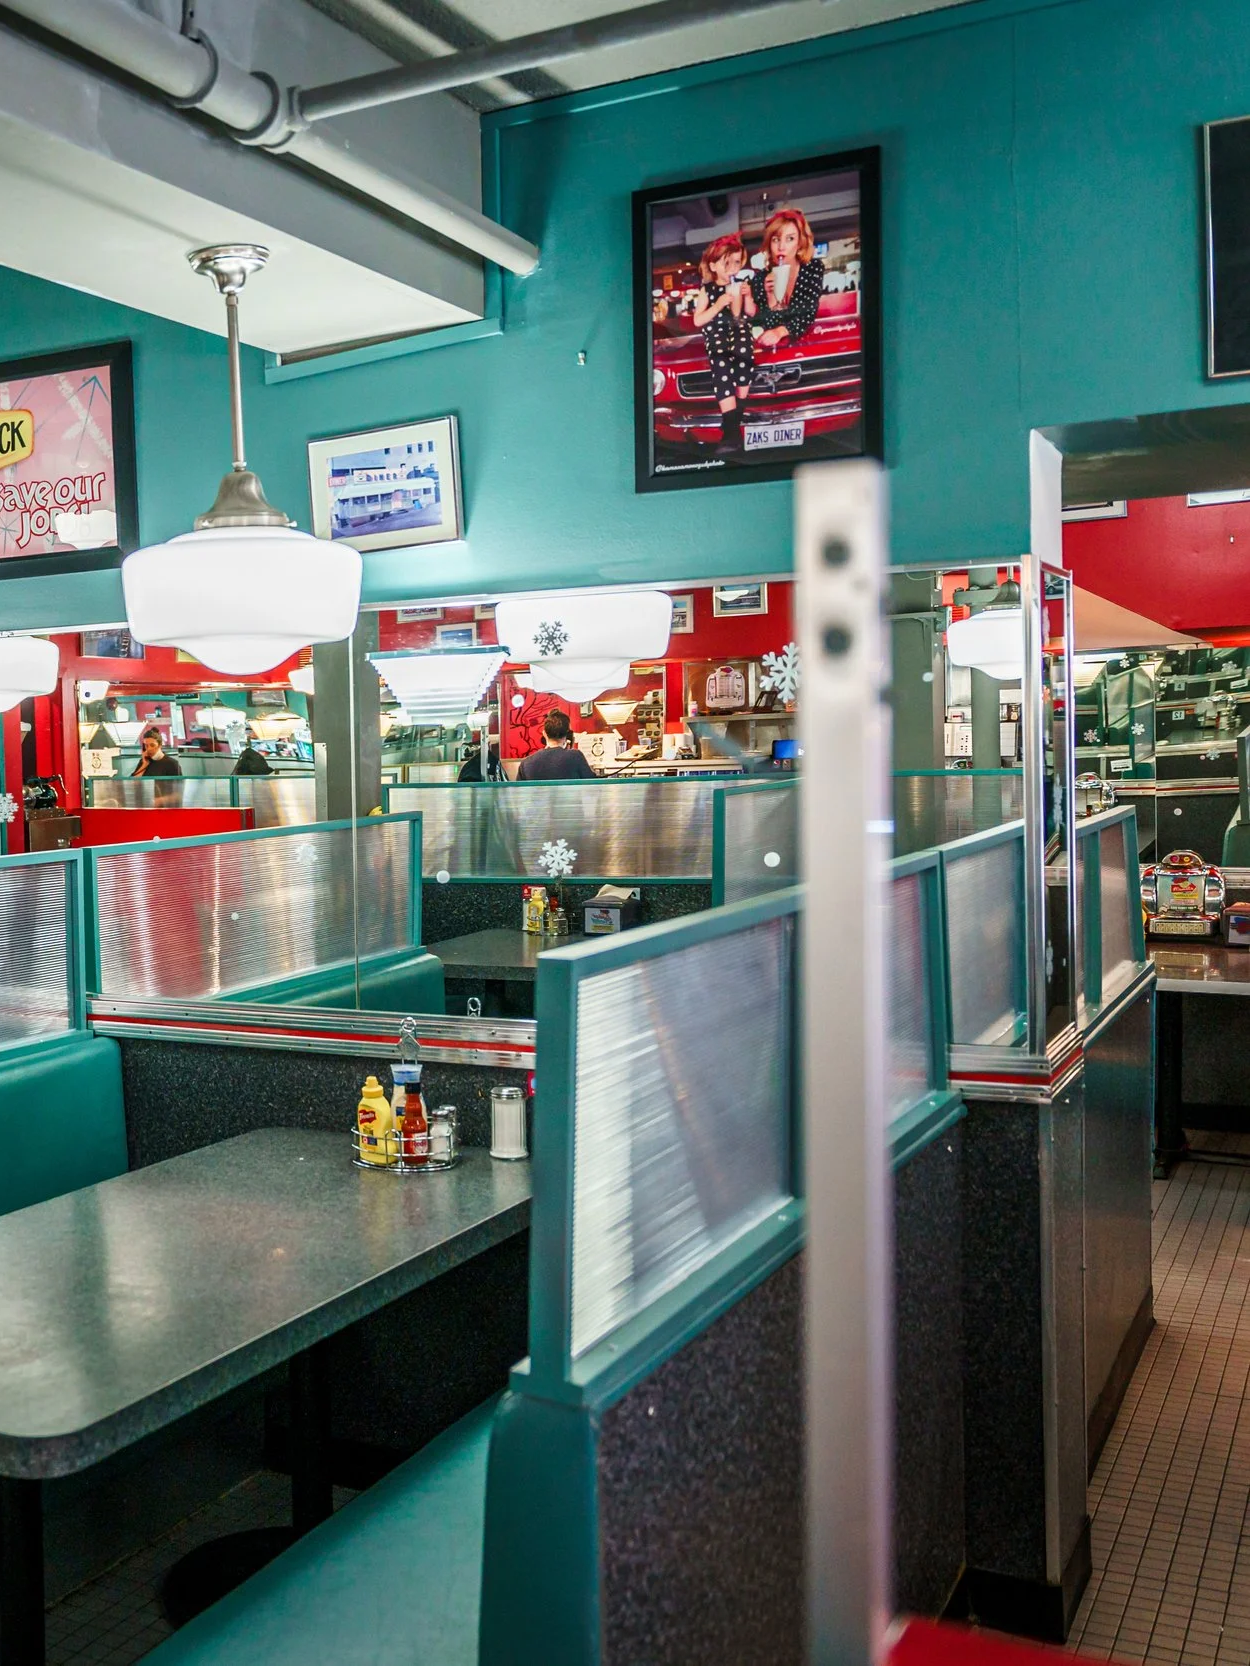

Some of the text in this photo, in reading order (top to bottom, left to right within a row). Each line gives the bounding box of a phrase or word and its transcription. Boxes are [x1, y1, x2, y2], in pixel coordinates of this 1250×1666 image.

[746, 428, 802, 445] ZAKS DINER
[53, 472, 106, 506] our
